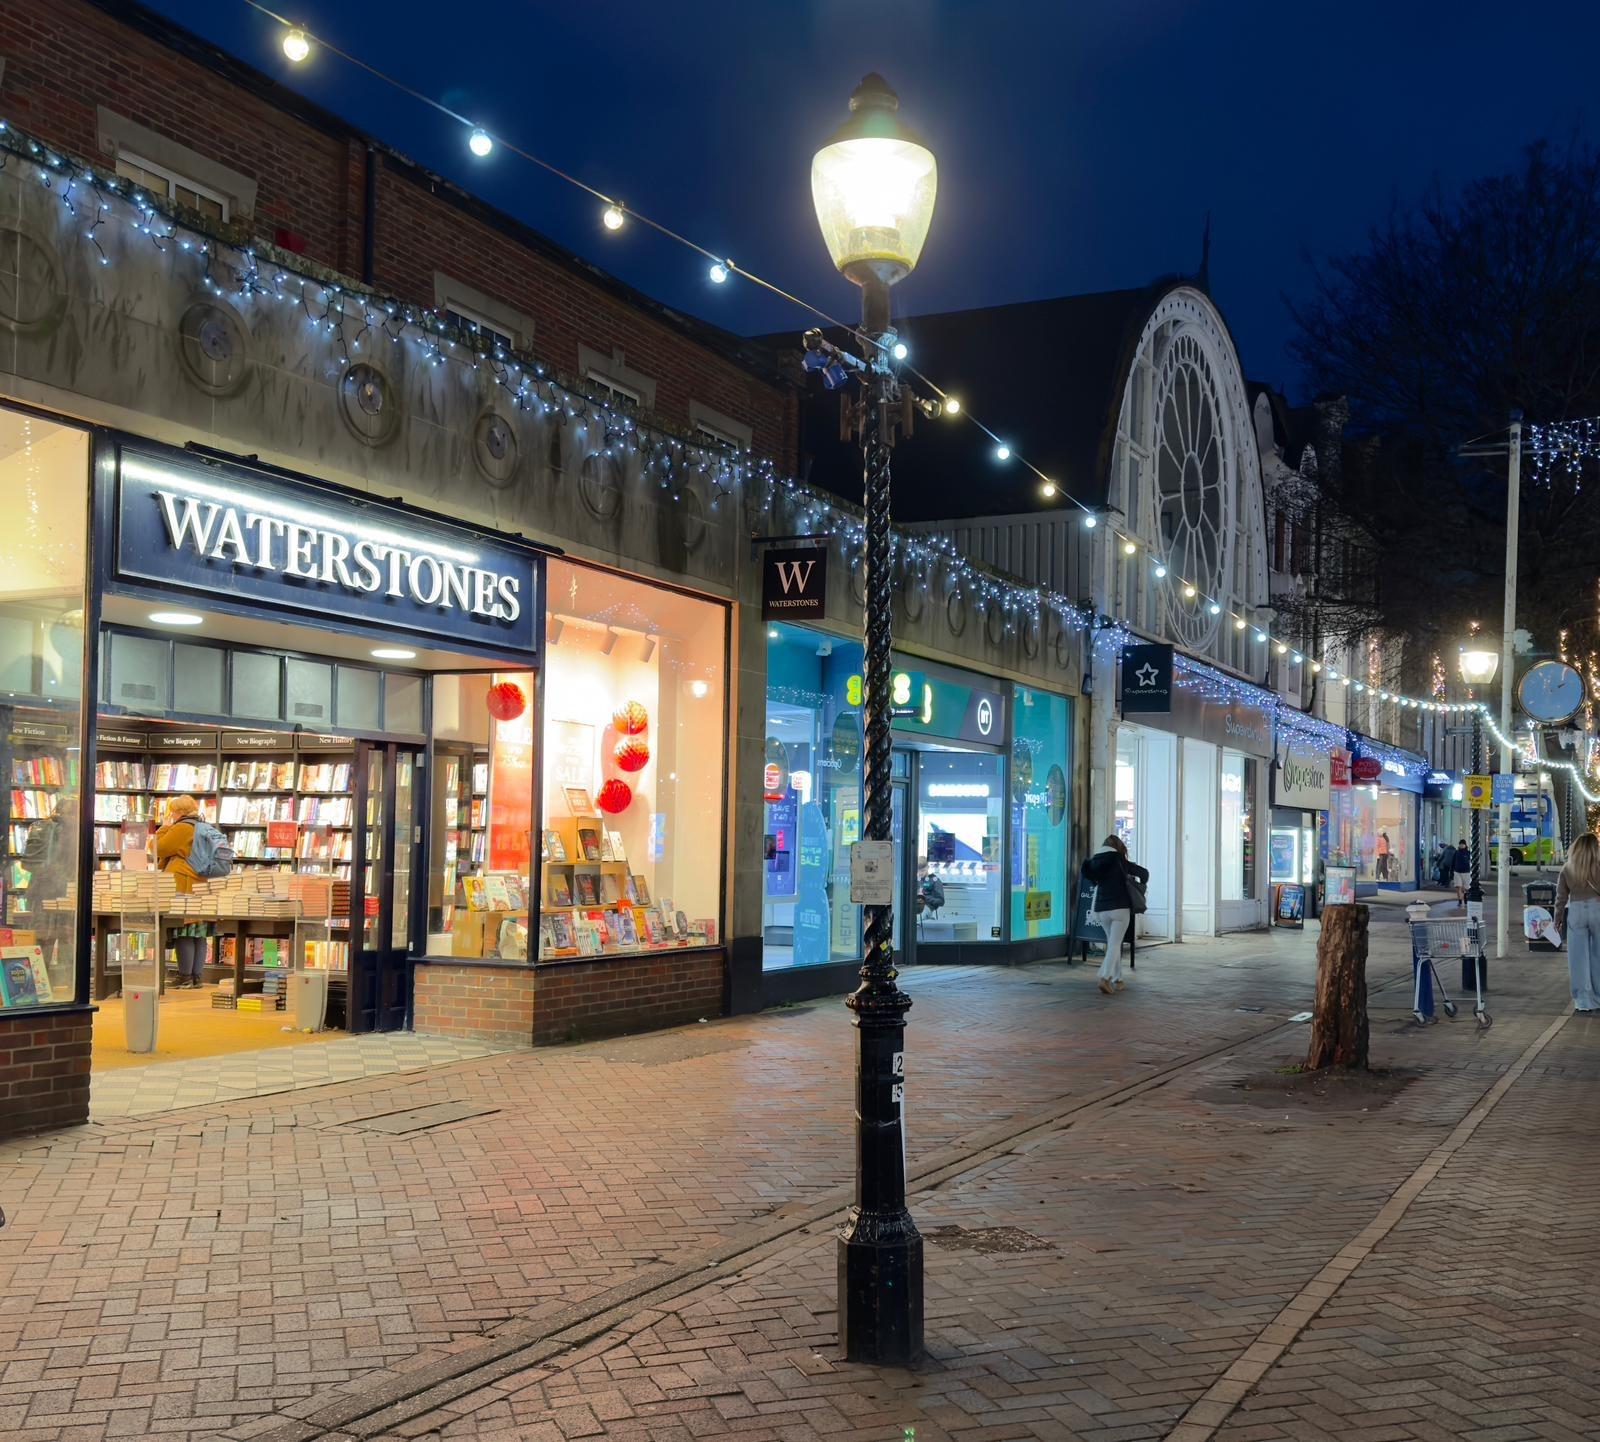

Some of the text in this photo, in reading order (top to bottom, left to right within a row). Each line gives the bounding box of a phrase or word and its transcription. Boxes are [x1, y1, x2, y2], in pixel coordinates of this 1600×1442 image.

[157, 491, 520, 622] WATERSTONES
[774, 560, 816, 594] W
[769, 599, 819, 608] WATERSTONES
[24, 727, 46, 736] Fiction
[163, 737, 202, 747] New Biography
[237, 737, 277, 747] New Biography
[332, 737, 354, 745] History
